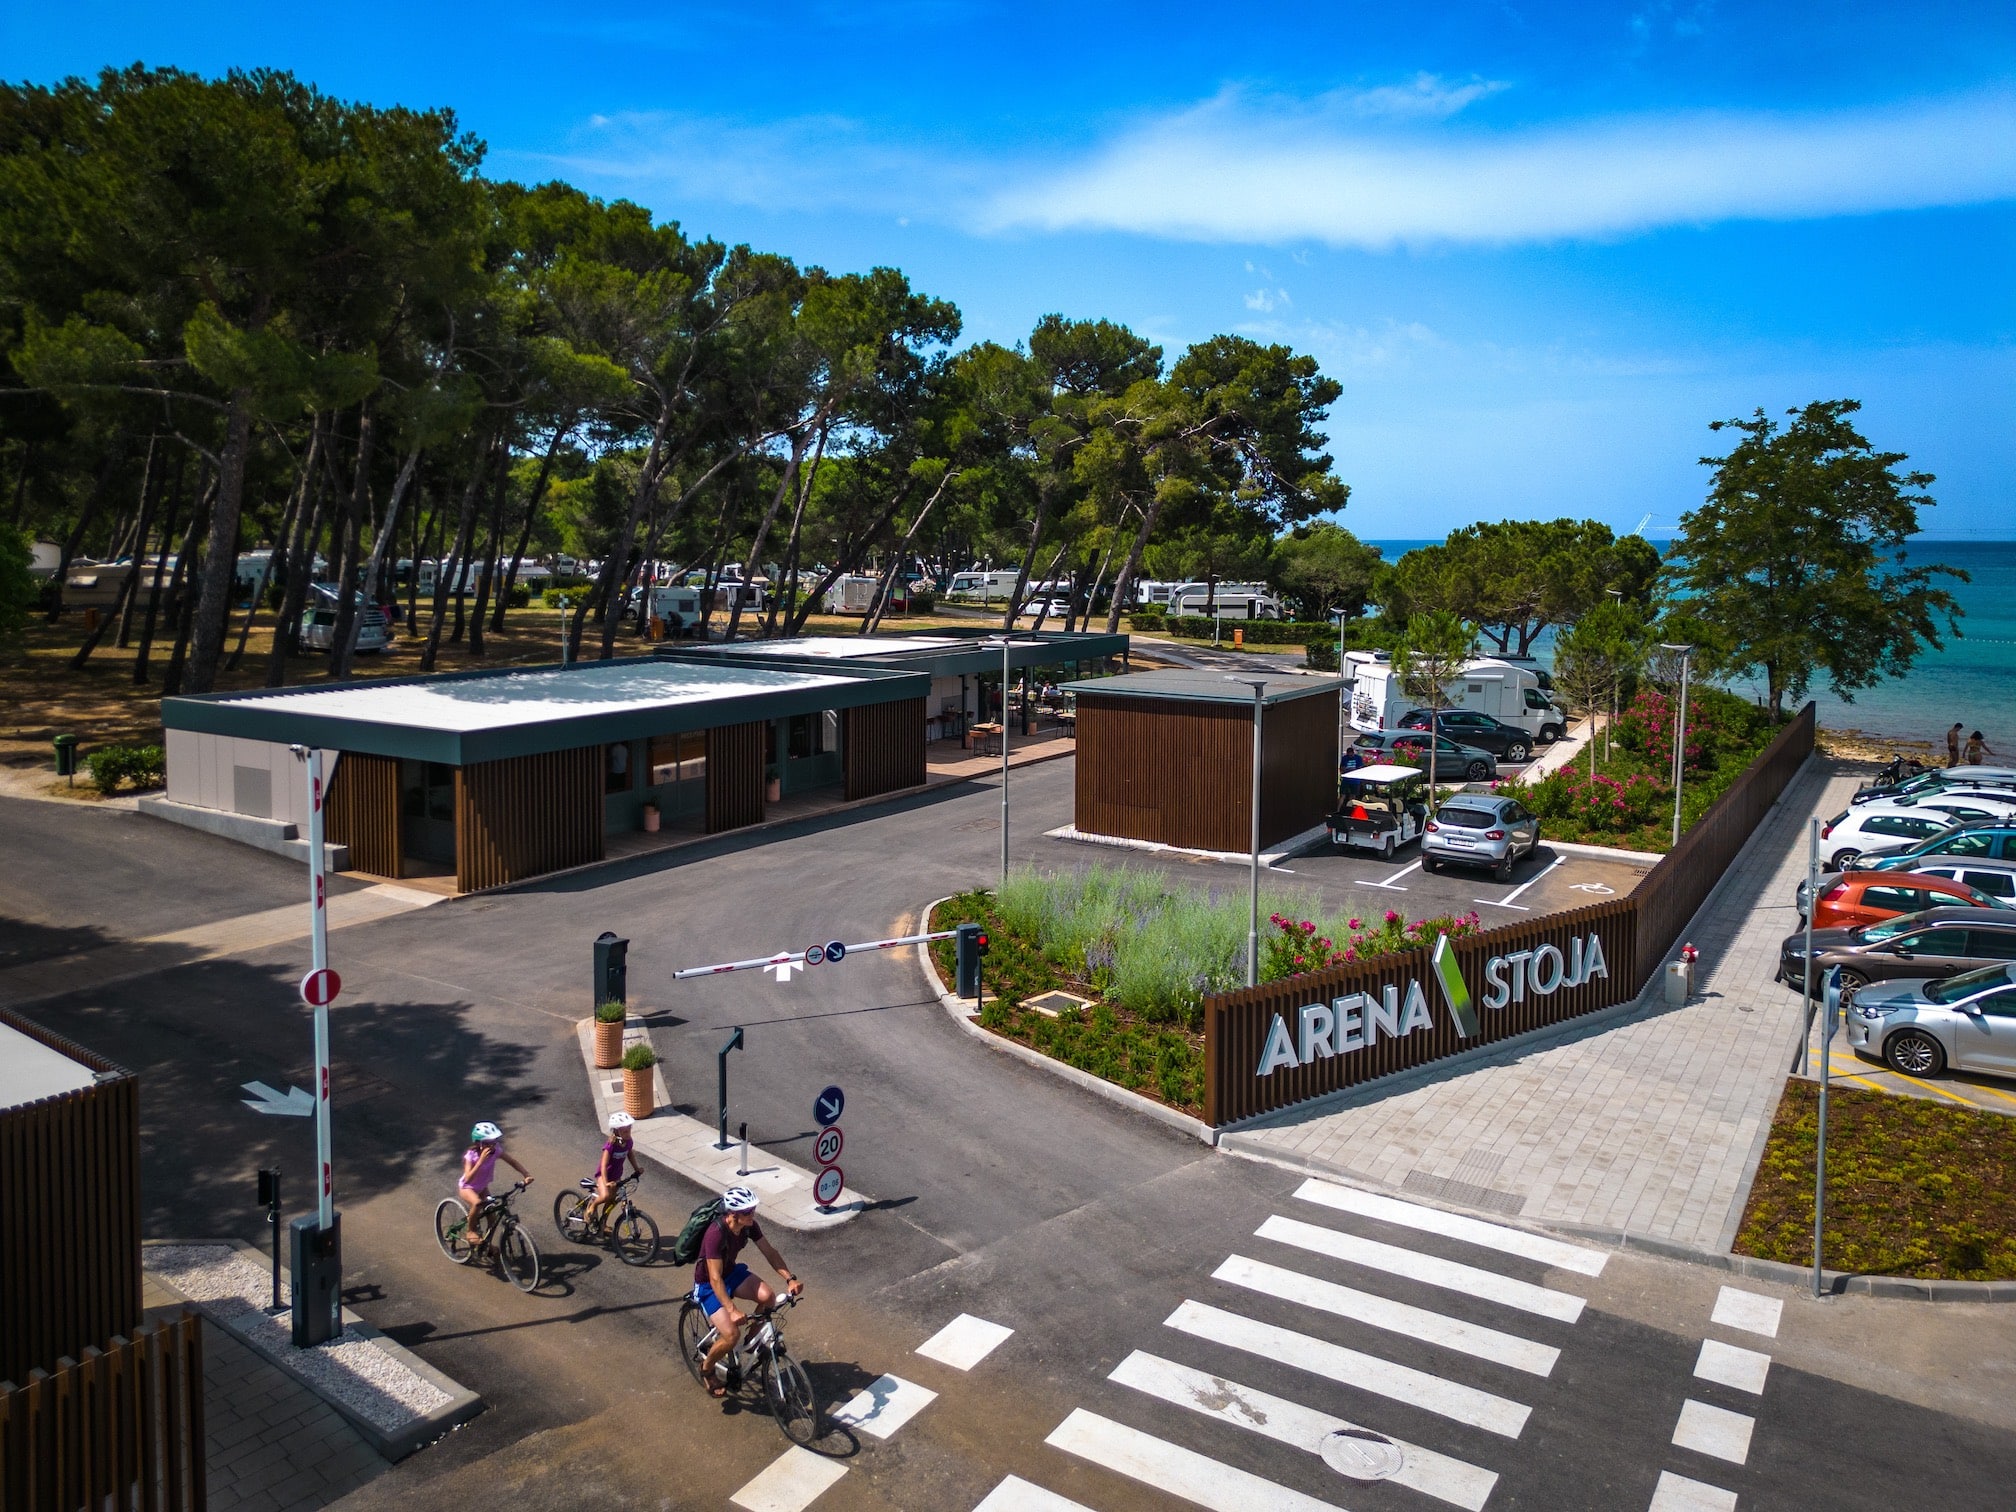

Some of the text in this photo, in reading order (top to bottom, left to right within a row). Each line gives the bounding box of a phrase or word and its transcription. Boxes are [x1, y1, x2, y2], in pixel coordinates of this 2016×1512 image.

[1256, 932, 1608, 1076] ARENA STOJA
[820, 1135, 839, 1158] 20
